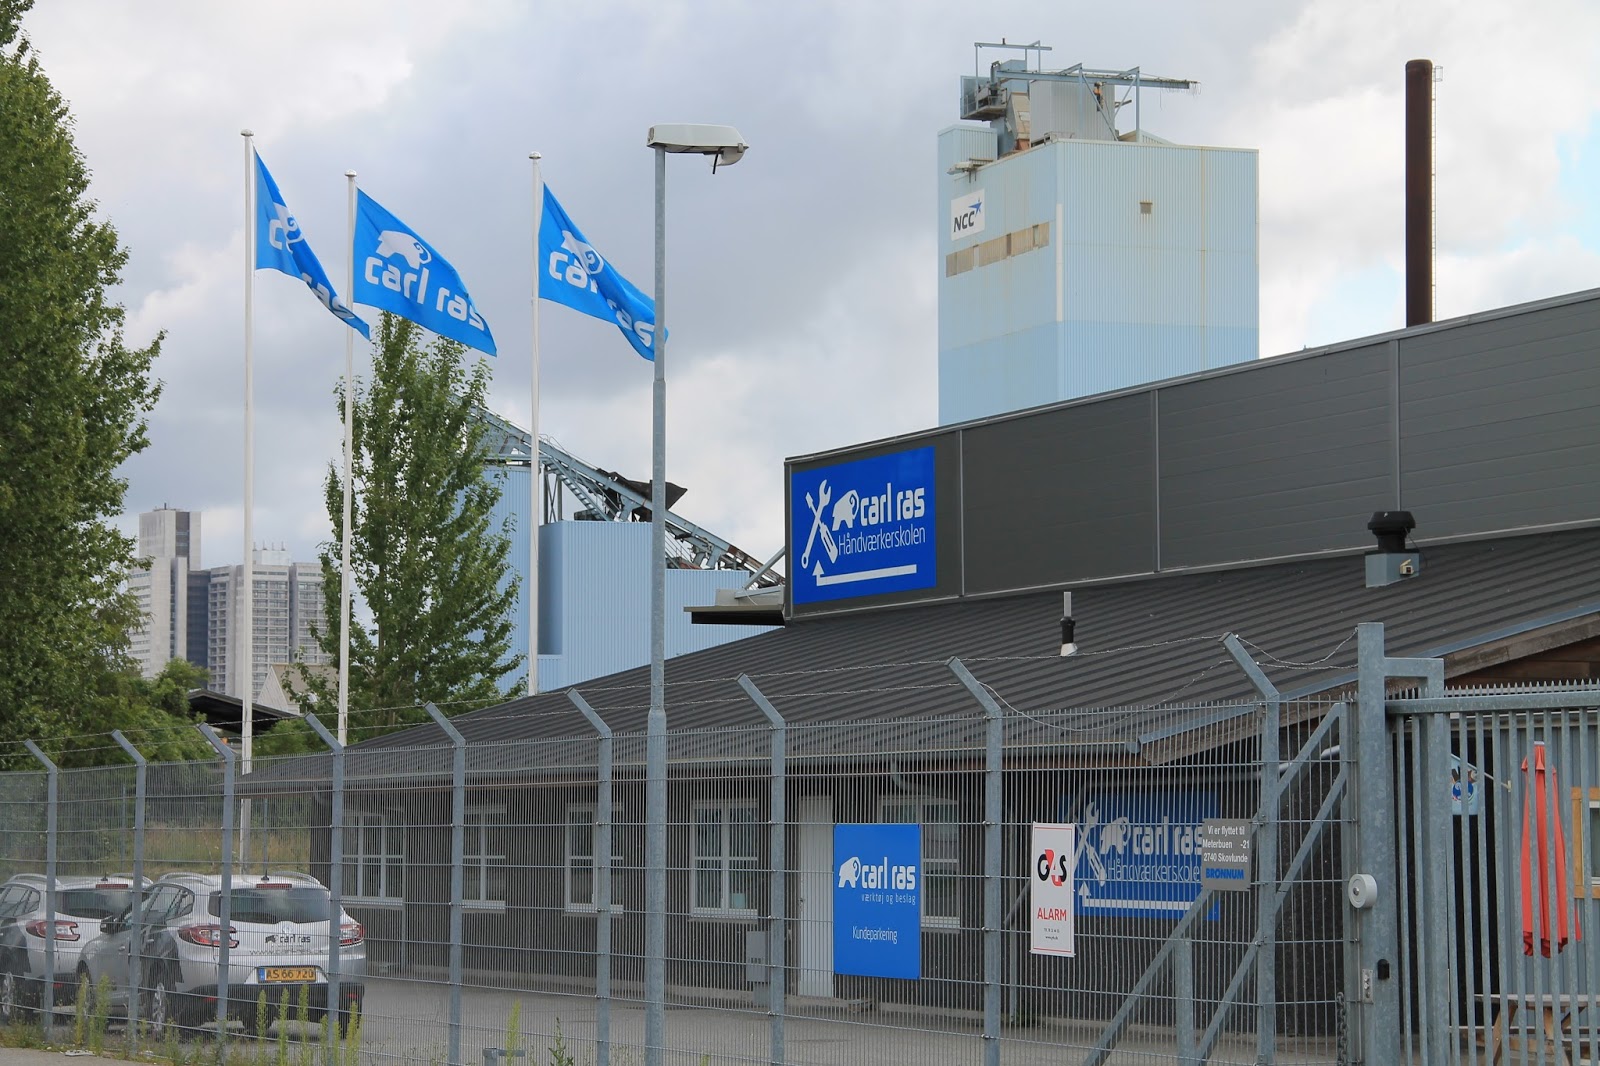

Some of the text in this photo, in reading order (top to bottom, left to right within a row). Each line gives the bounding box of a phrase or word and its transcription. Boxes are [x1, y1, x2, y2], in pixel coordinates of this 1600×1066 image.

[953, 211, 975, 233] NCC
[365, 256, 484, 331] carl ras
[860, 482, 925, 526] carl ras
[838, 523, 926, 556] Håndværkerskolen
[1132, 816, 1203, 855] carl ras
[1207, 825, 1214, 835] Vi
[1037, 849, 1067, 887] G4S
[1203, 852, 1217, 862] 2740
[861, 856, 916, 890] carl ras
[1107, 858, 1201, 881] Håndværkerskole
[1037, 907, 1067, 922] ALARM
[279, 934, 296, 943] carl
[852, 926, 898, 945] Kundeparkering
